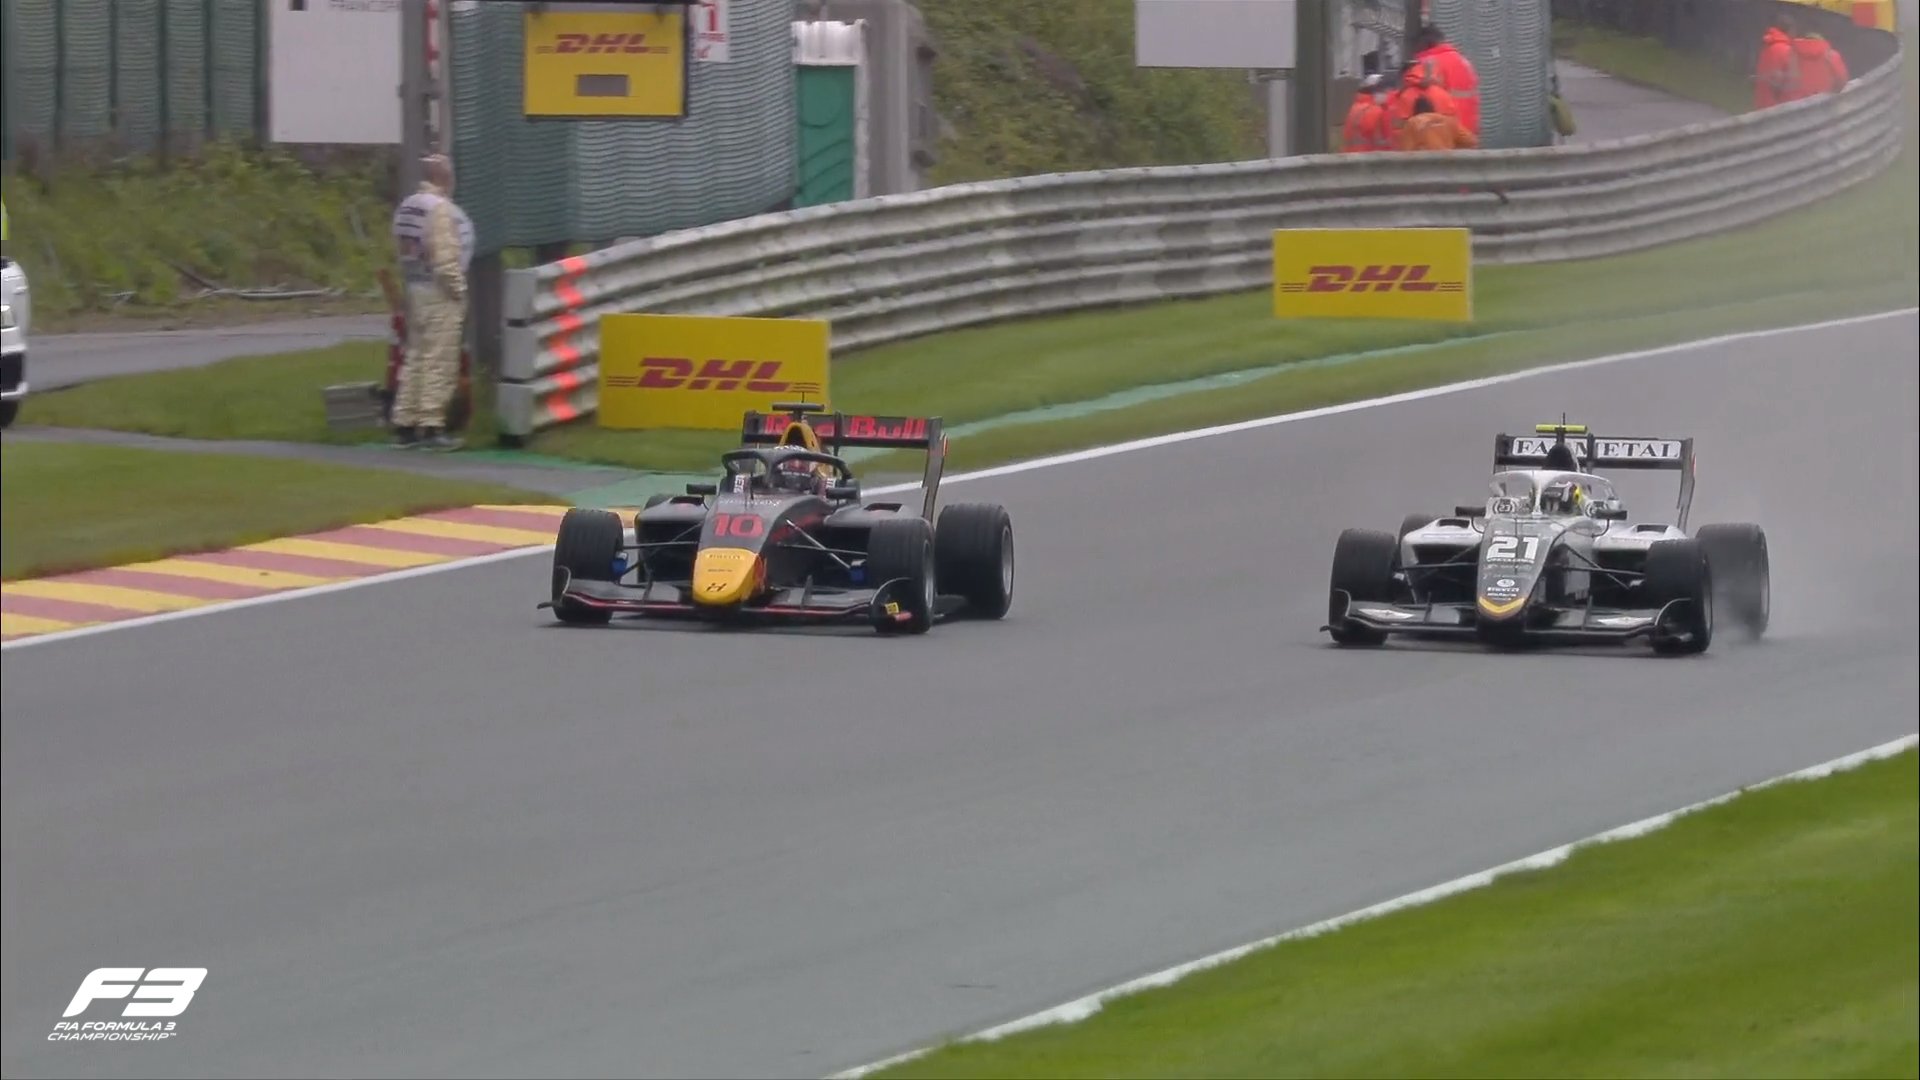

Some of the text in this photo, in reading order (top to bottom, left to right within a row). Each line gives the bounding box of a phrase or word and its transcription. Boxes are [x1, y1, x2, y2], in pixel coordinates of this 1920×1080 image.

[555, 33, 649, 54] DHL
[1306, 264, 1438, 292] DHL
[636, 356, 792, 393] DHL
[765, 414, 926, 439] Rd Bull
[714, 512, 764, 538] 10
[1486, 535, 1539, 560] 21
